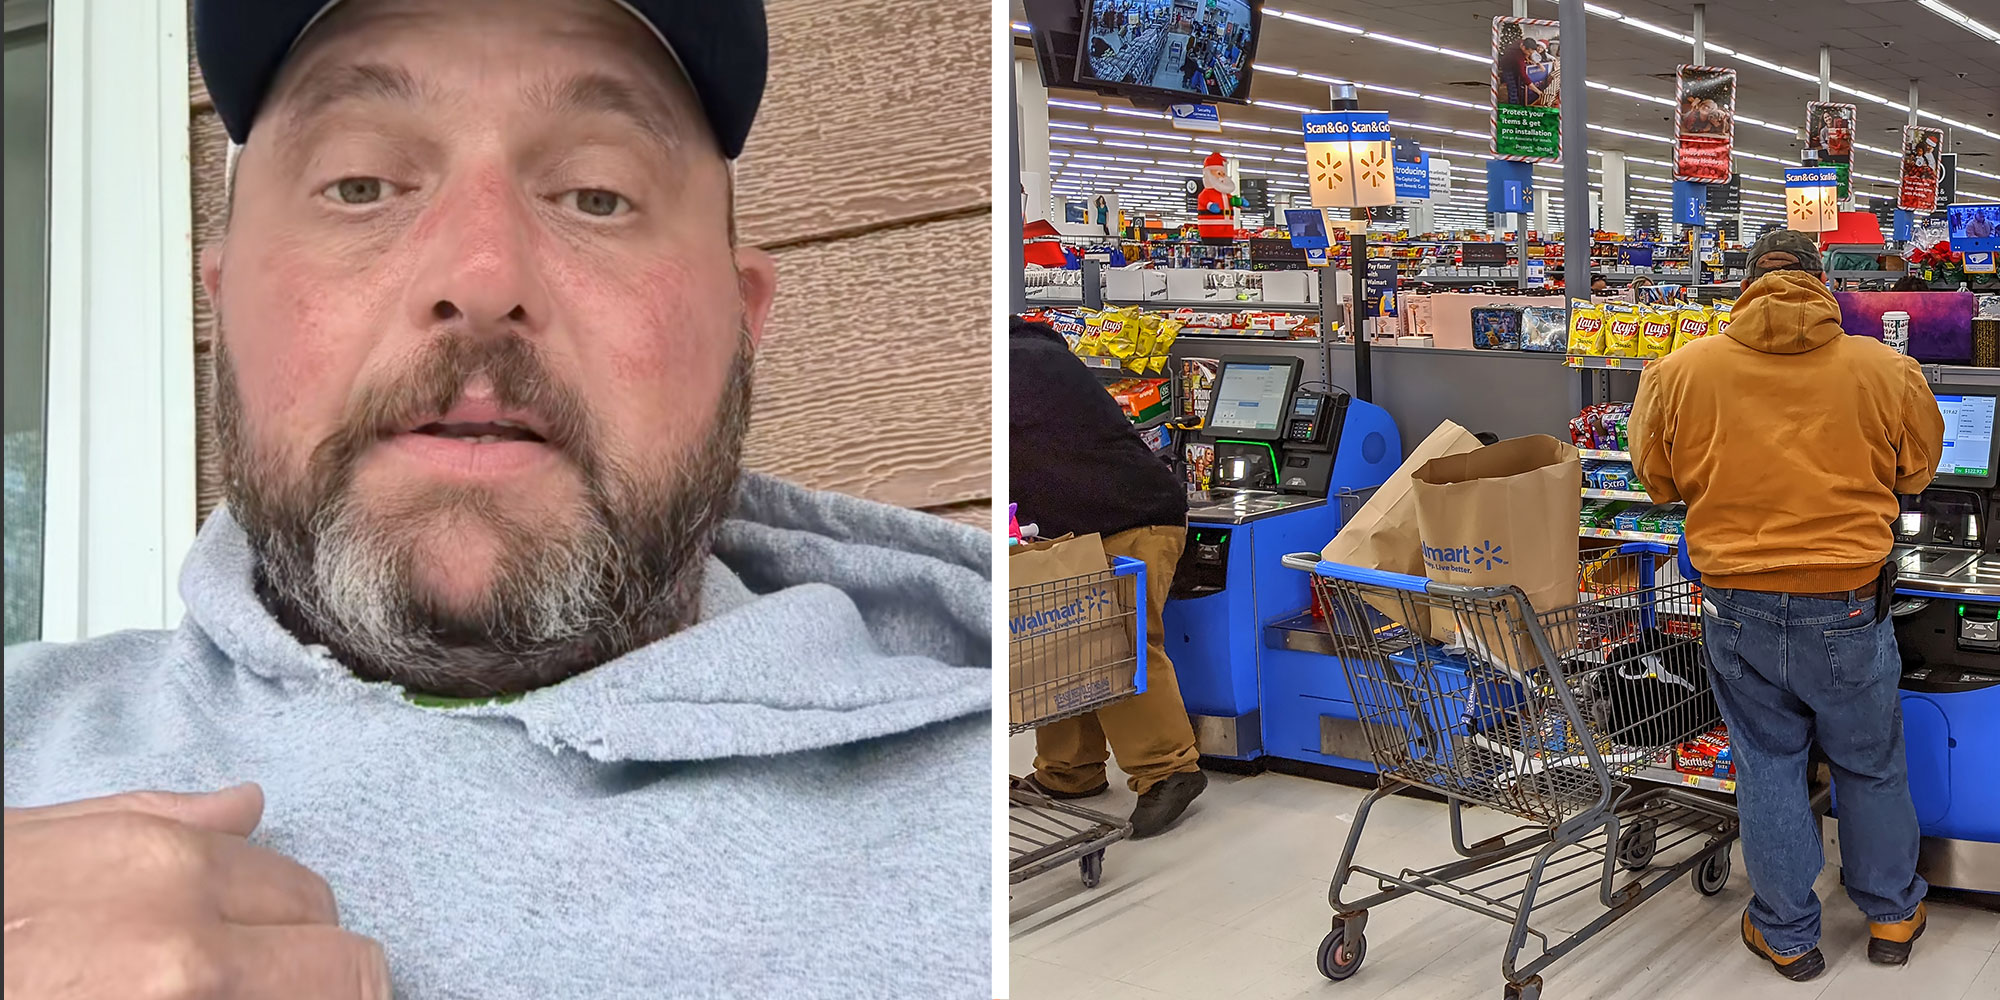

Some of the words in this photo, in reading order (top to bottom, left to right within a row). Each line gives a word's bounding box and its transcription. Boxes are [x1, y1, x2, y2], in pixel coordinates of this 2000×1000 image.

[1502, 108, 1528, 116] Protect
[1306, 122, 1349, 134] Scan&Go
[1352, 121, 1390, 132] Scan&Go
[1394, 166, 1426, 178] troducing
[1786, 173, 1819, 182] Scan&Go
[1511, 186, 1516, 204] 1
[1690, 202, 1695, 218] 3
[1102, 320, 1122, 332] Lay's
[1577, 316, 1600, 332] Lay's
[1613, 320, 1637, 336] Lay's
[1644, 322, 1670, 337] Lay's
[1682, 318, 1706, 336] Lay's
[1602, 480, 1625, 489] Extra
[1422, 540, 1470, 564] lmart
[1450, 564, 1472, 574] better.
[1009, 598, 1085, 634] Walmart
[1679, 757, 1714, 768] Skittles
